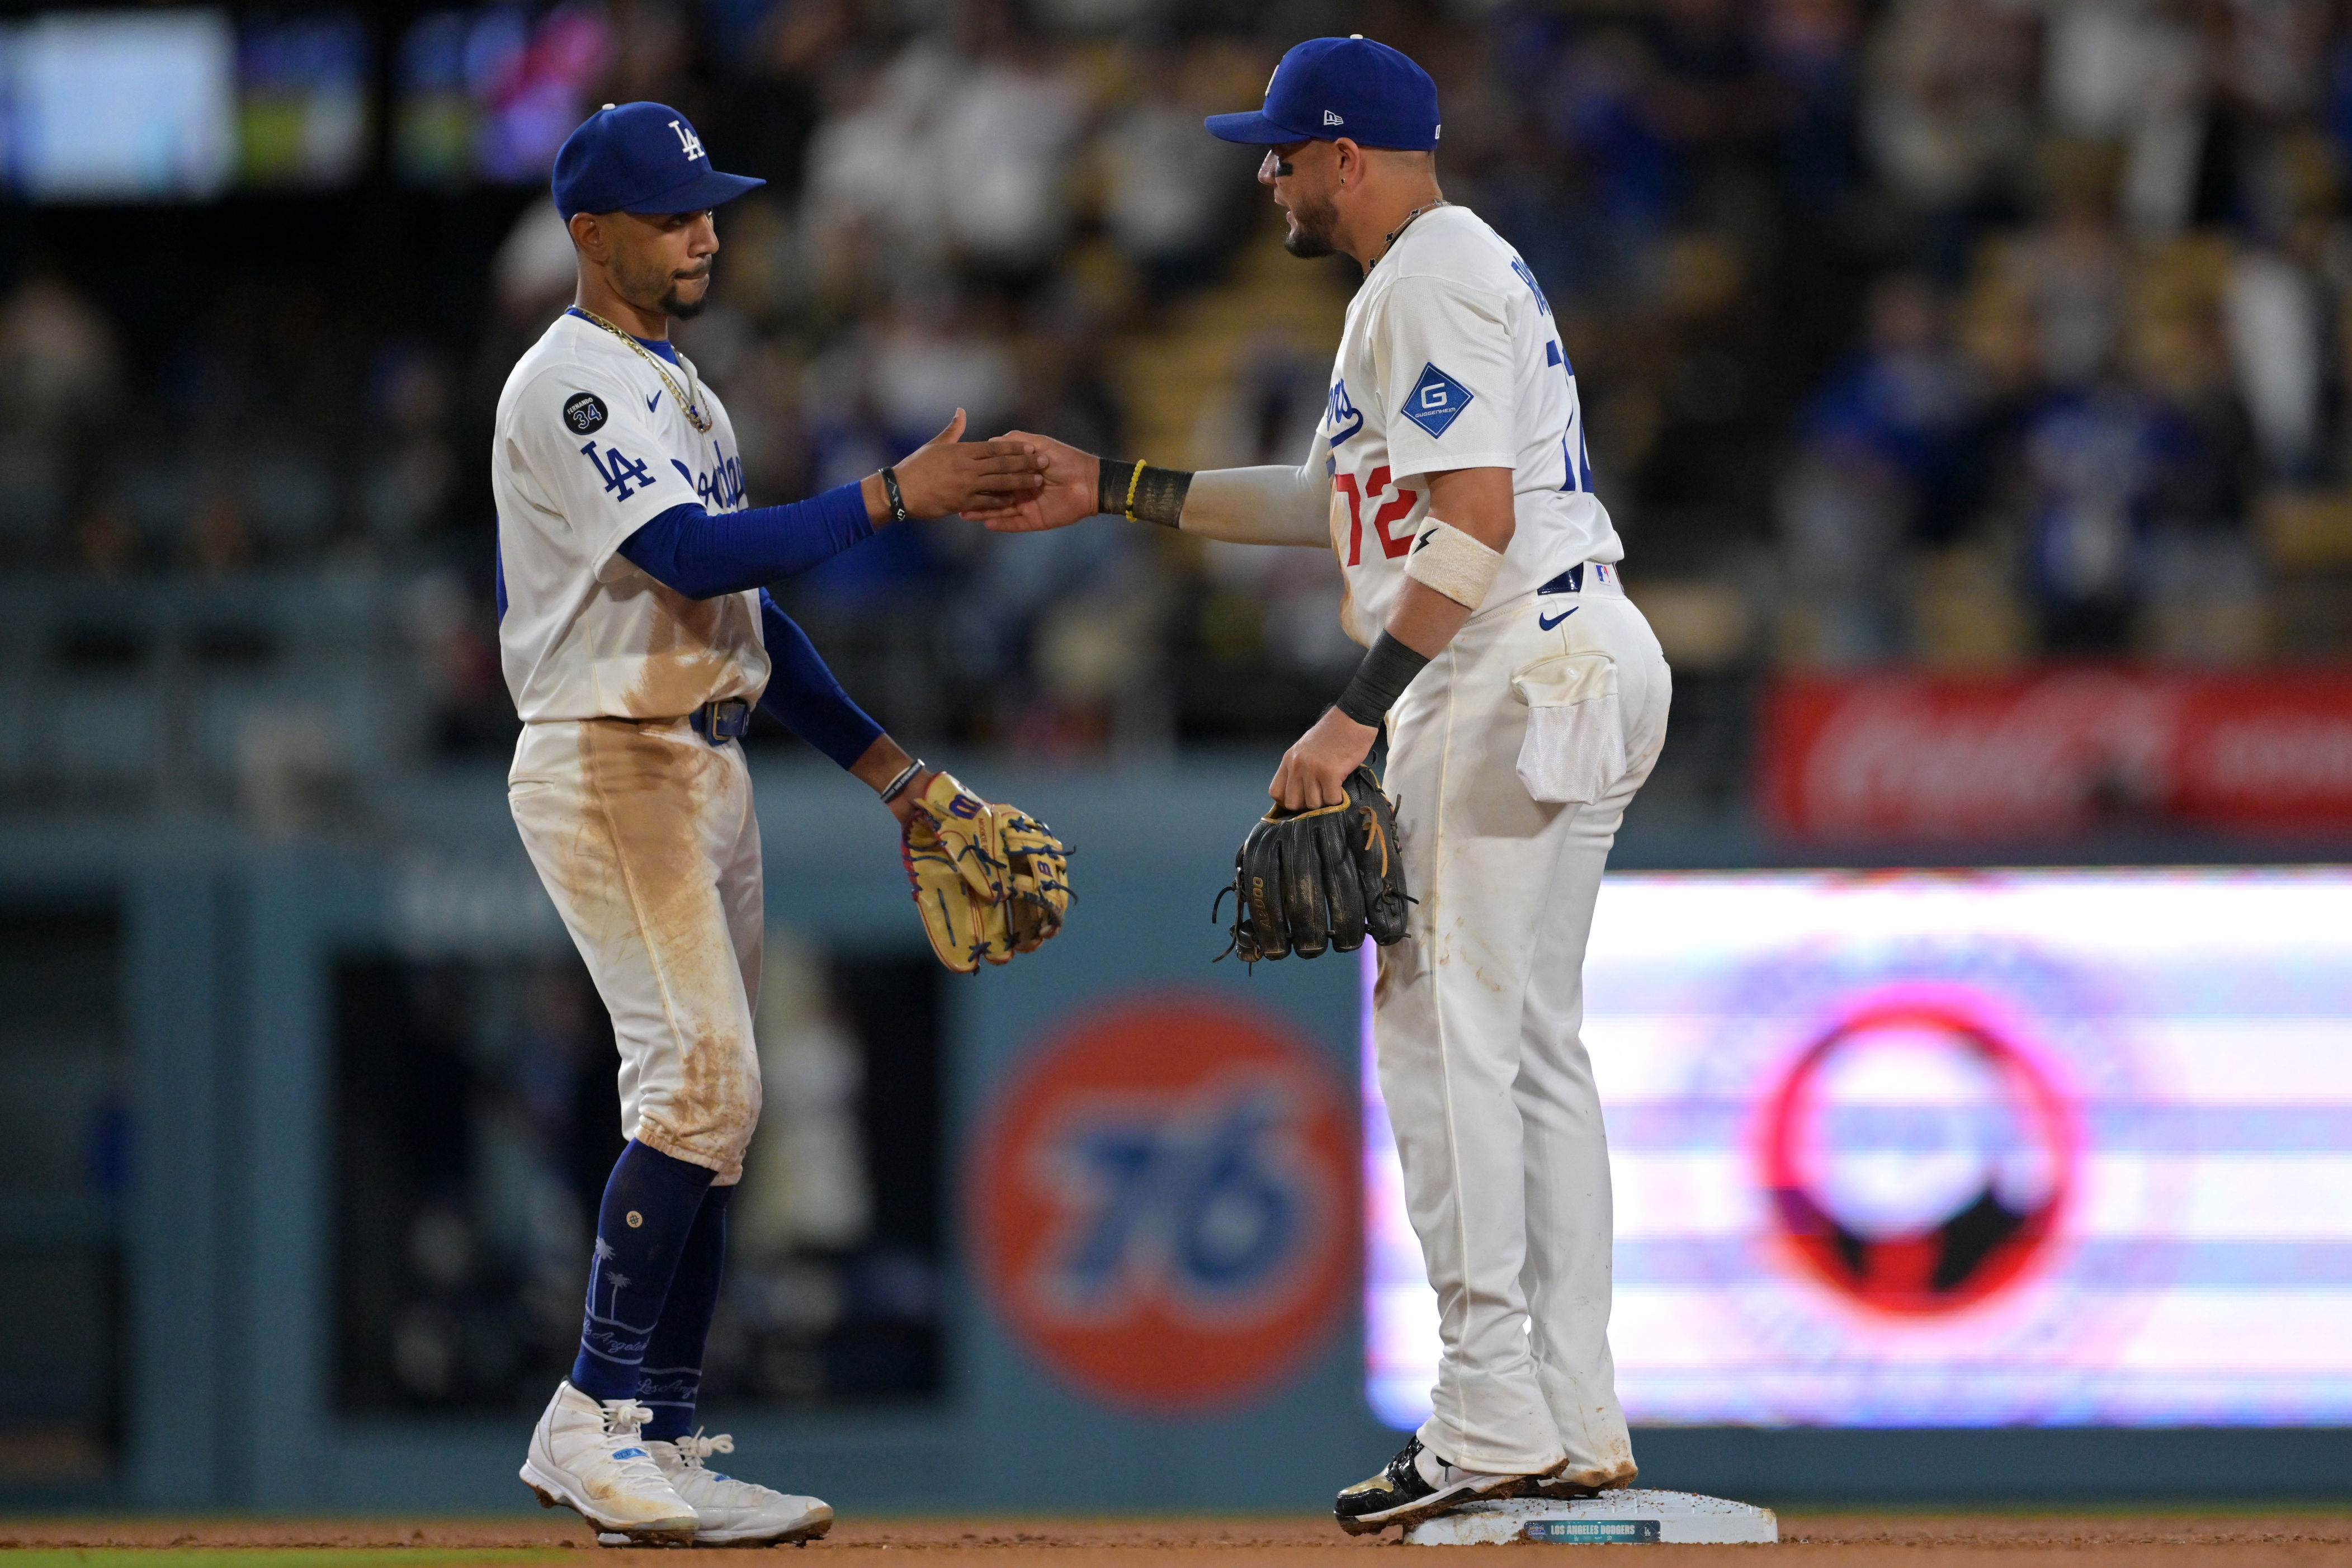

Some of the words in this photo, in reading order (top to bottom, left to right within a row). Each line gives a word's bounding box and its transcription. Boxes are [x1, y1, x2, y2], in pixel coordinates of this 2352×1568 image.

[668, 120, 705, 161] LA
[567, 397, 593, 414] FERNANDO
[1421, 382, 1447, 409] G
[573, 404, 602, 429] 34
[1415, 407, 1456, 418] GUGGENHEIM
[580, 441, 657, 502] LA
[1335, 465, 1418, 566] 72
[1551, 1525, 1565, 1535] LOS
[1567, 1525, 1599, 1535] ANGELES
[1600, 1525, 1635, 1535] DODGERS
